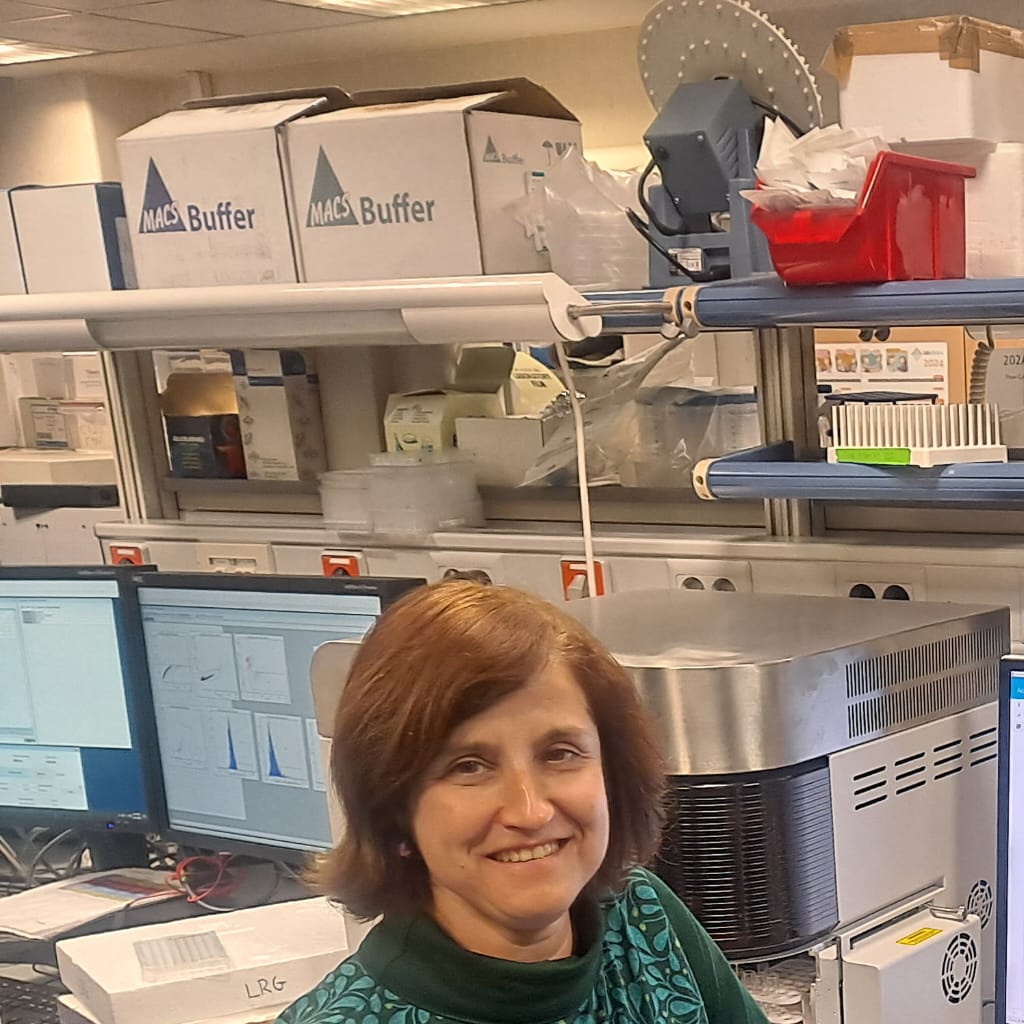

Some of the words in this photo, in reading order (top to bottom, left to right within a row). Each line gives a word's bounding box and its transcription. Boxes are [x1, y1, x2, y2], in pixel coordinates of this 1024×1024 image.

[141, 201, 179, 233] MACS
[186, 201, 256, 233] Buffer
[310, 192, 351, 226] MACS
[359, 192, 436, 226] Buffer
[244, 975, 288, 999] LRG
